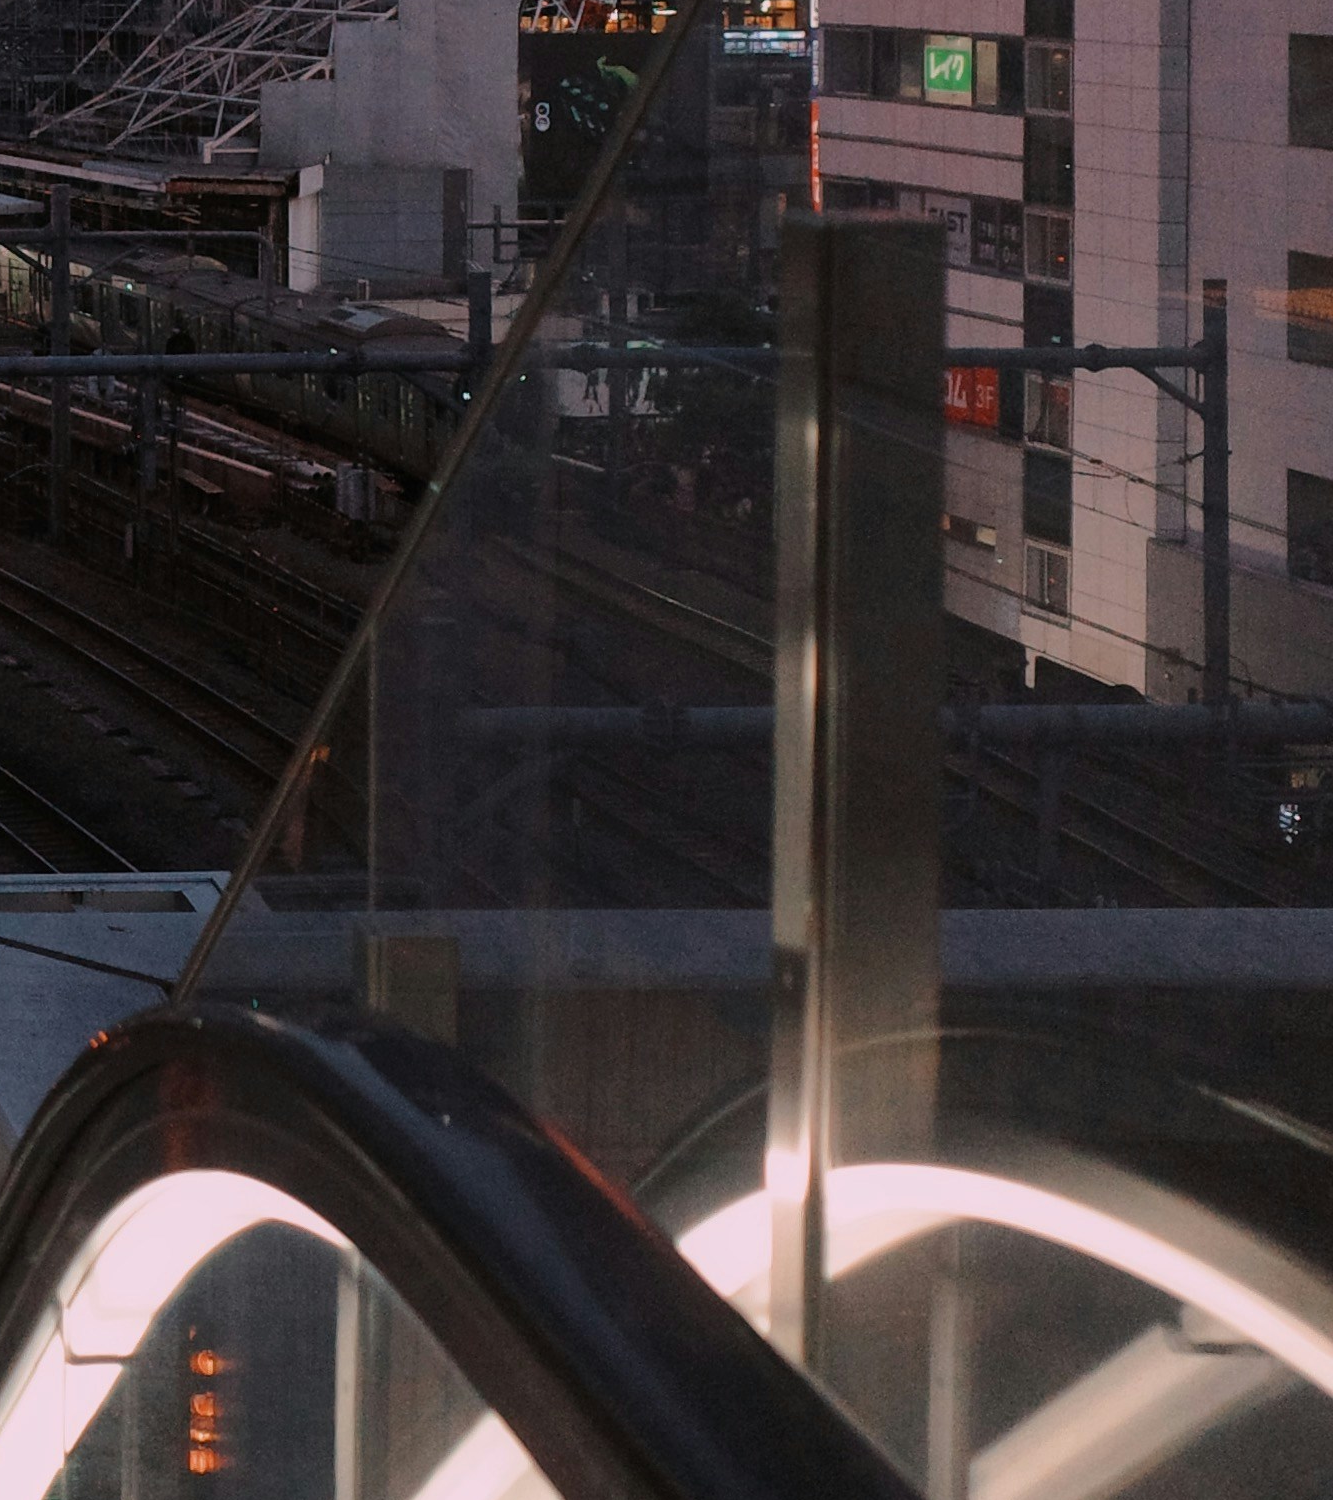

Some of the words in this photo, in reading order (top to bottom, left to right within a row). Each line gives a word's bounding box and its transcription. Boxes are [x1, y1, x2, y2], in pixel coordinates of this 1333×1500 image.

[929, 51, 965, 81] レイク
[975, 384, 994, 410] 3F
